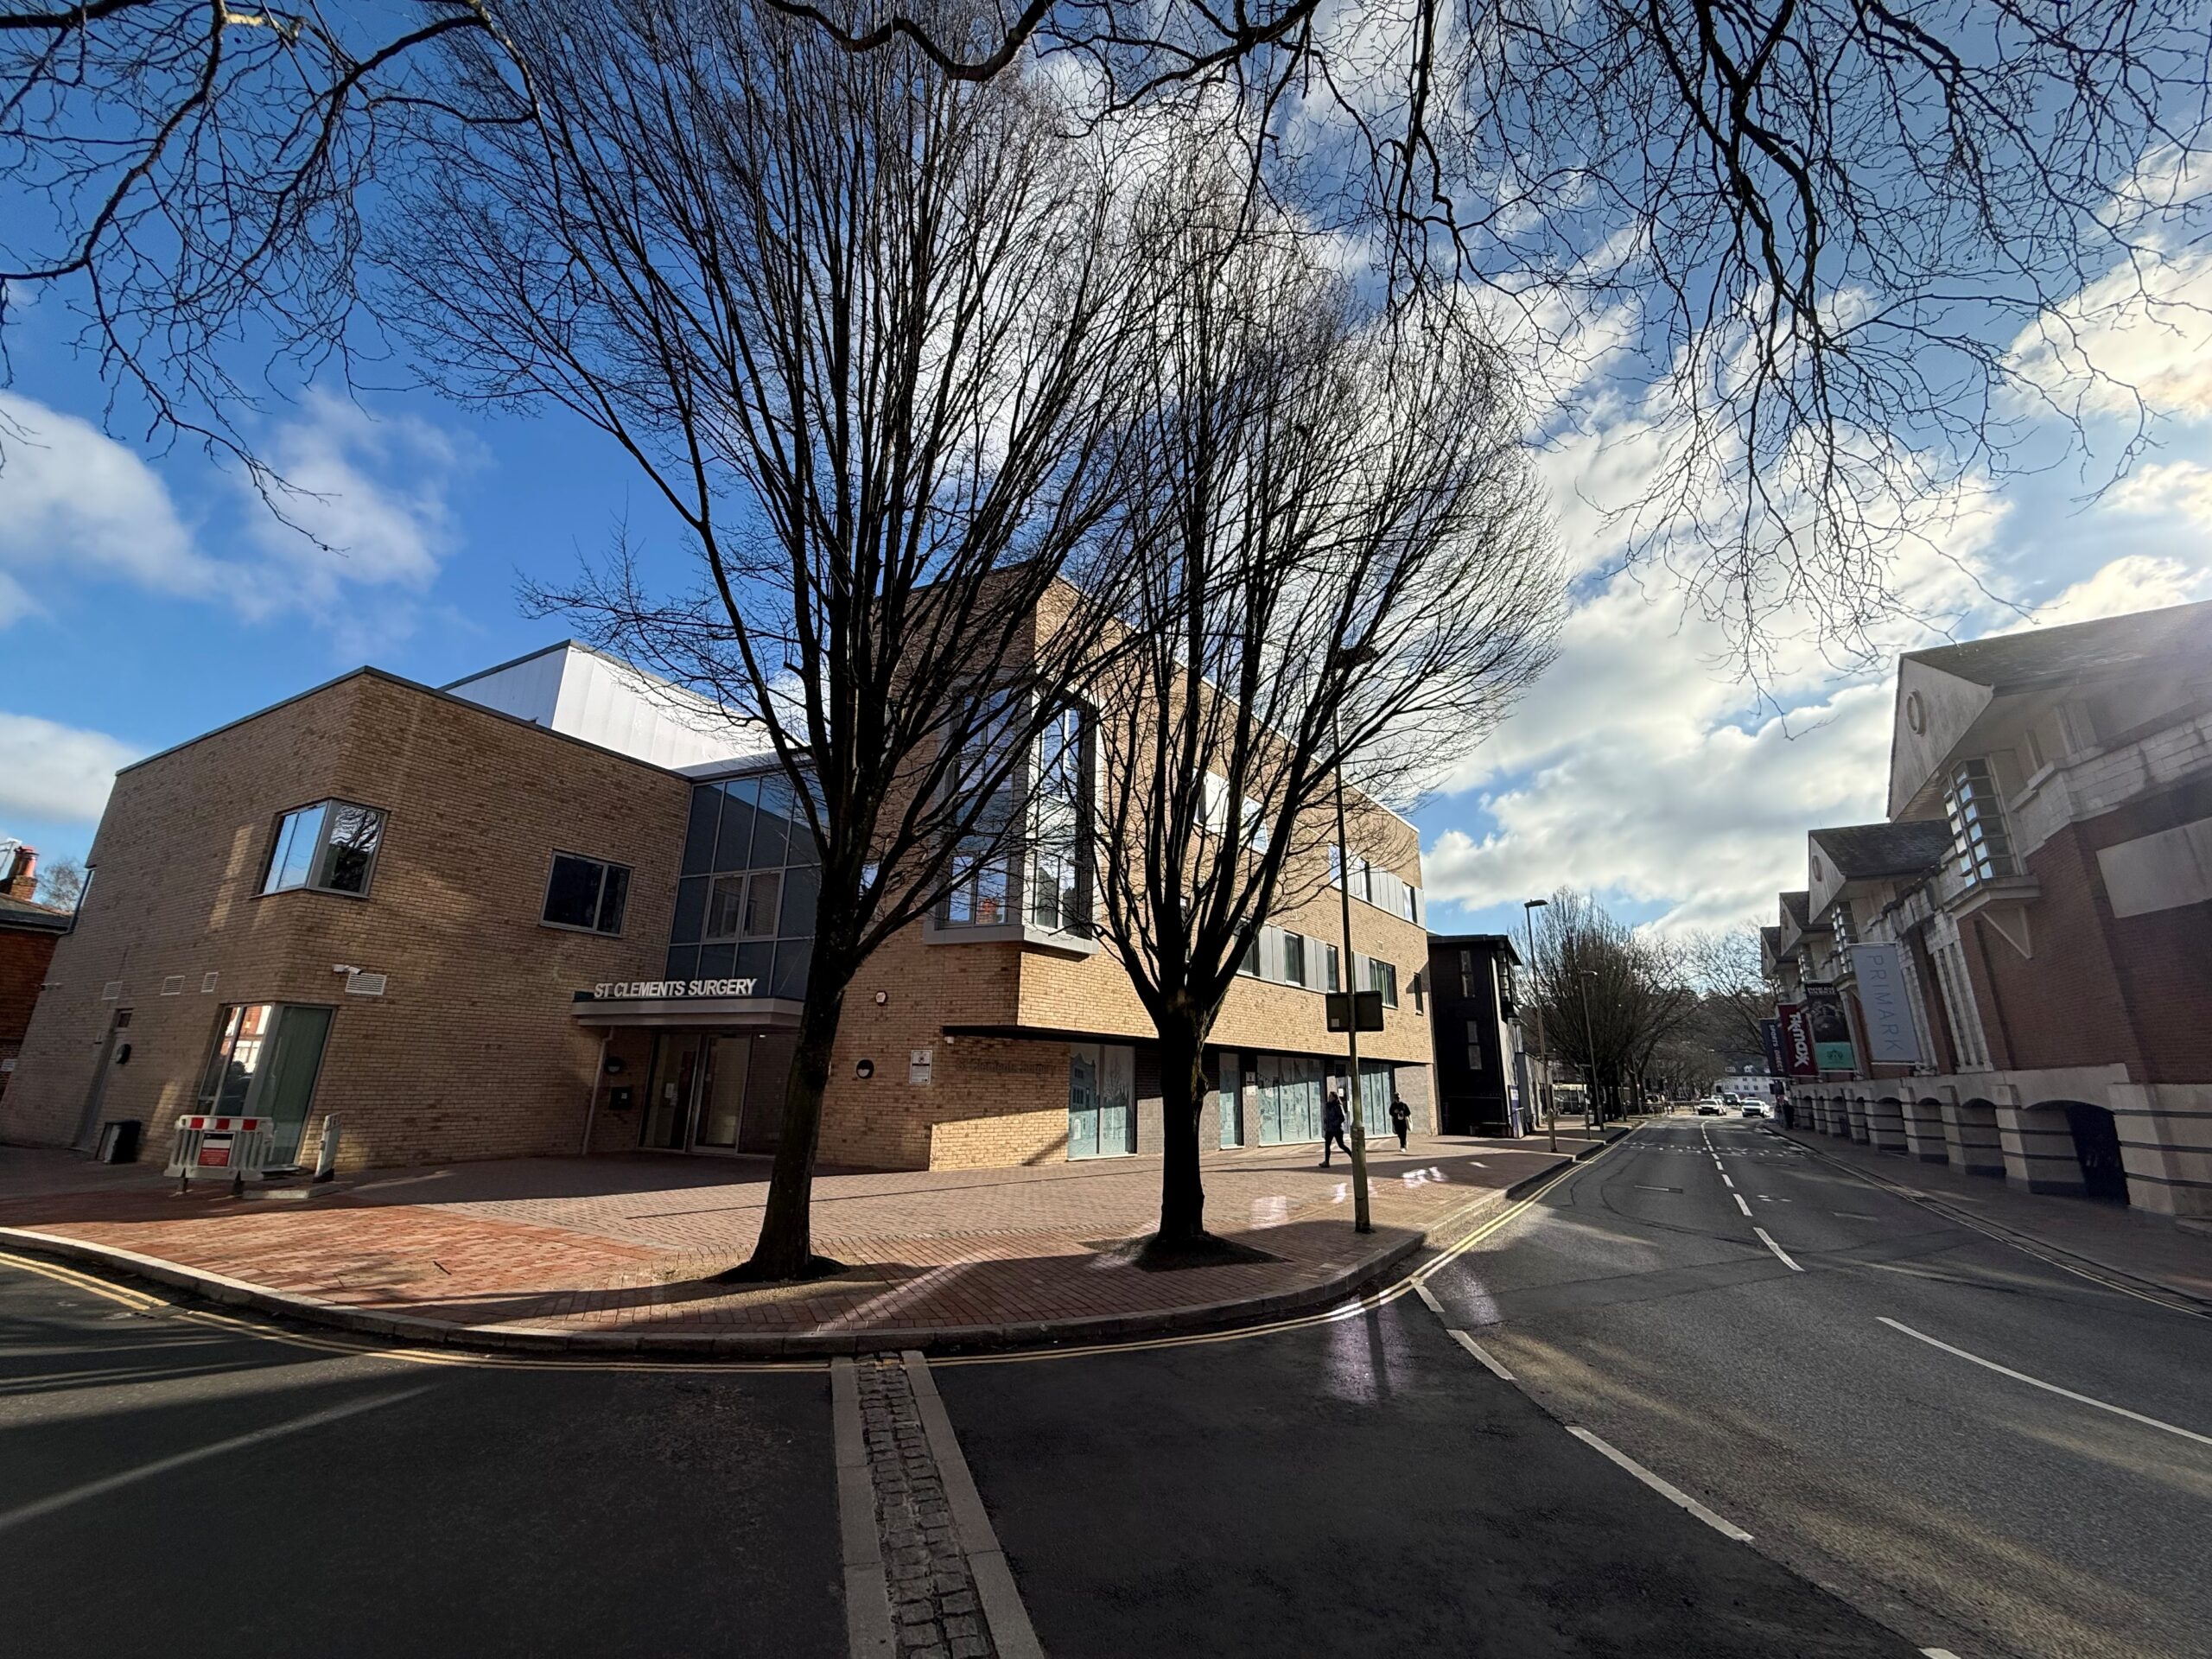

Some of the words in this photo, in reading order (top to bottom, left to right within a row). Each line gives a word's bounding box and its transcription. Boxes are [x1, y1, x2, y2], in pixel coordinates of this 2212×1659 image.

[594, 982, 613, 998] ST
[613, 981, 686, 998] CLEMENTS
[688, 978, 758, 996] SURGERY
[1866, 955, 1904, 1051] PRIMARK
